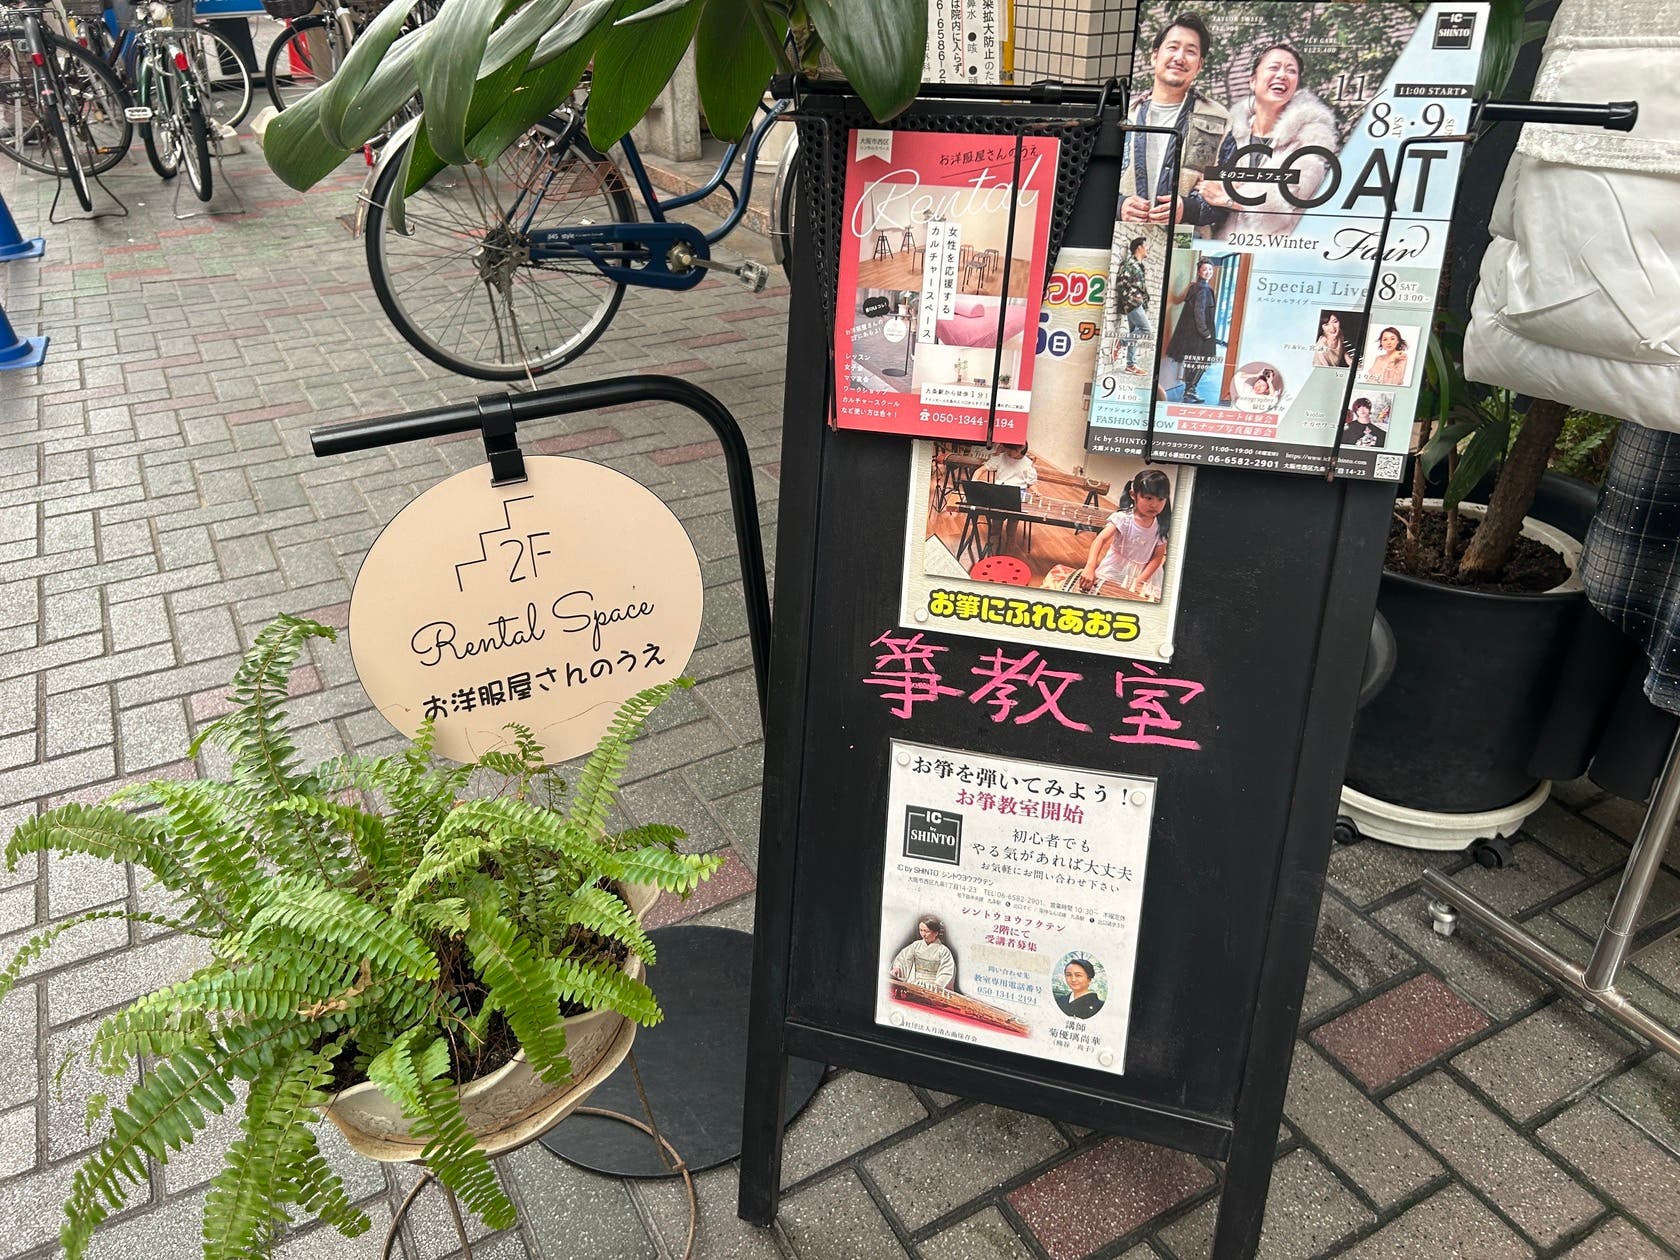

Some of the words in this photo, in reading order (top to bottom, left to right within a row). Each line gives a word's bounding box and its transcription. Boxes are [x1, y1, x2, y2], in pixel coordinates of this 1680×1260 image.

[1451, 14, 1463, 23] IC
[982, 0, 996, 85] 染拡大防止のた
[1438, 29, 1470, 37] SHINTO
[1332, 75, 1366, 102] 11
[1400, 87, 1425, 95] 11:00
[1427, 87, 1460, 96] START
[1367, 102, 1391, 138] 8
[1421, 103, 1445, 137] 9
[939, 144, 1039, 166] お洋服屋さんのうえ
[1218, 169, 1294, 183] 冬のコートフェア
[1223, 143, 1449, 213] COAT
[851, 153, 1042, 238] Rental
[1228, 231, 1320, 251] 2025.Winter
[1322, 225, 1430, 262] Fair
[943, 226, 958, 314] 女性を応援する
[922, 226, 940, 338] カルチャースペース
[1257, 277, 1322, 295] Special
[1331, 281, 1369, 298] Live
[1378, 273, 1397, 301] 8
[1400, 283, 1417, 291] SAT
[845, 353, 871, 361] レッスン
[843, 386, 888, 396] ワークショップ
[1102, 376, 1116, 398] 9
[1118, 384, 1133, 392] SUN
[842, 396, 900, 408] カルチャースクール
[932, 412, 1014, 429] 050-1344-194
[1096, 415, 1141, 427] FASHION
[1103, 435, 1112, 444] by
[1114, 436, 1147, 446] SHINTO
[1208, 454, 1279, 468] 06-6582-2901
[500, 532, 552, 583] 2F
[928, 588, 1141, 641] お箏にふれあおう
[411, 602, 546, 667] Rental
[552, 590, 655, 652] Space
[422, 642, 666, 719] お洋服屋さんのうえ
[955, 788, 1085, 825] お箏教室開始
[925, 811, 943, 824] IC
[910, 829, 956, 847] SHINTO
[1012, 828, 1091, 853] 初心者でも
[972, 842, 1133, 882] やる気があれば大丈夫
[913, 866, 939, 877] SHINTO
[941, 871, 994, 886] シントウヨウフクテン
[980, 861, 1120, 893] お気軽にお問い合わせ下さい
[962, 907, 1066, 932] シントウヨウフクテン
[993, 924, 1031, 939] 2階にて
[985, 934, 1038, 952] 受講者募集
[974, 973, 1043, 994] 教室専用電話番号
[1065, 1019, 1087, 1032] 講師
